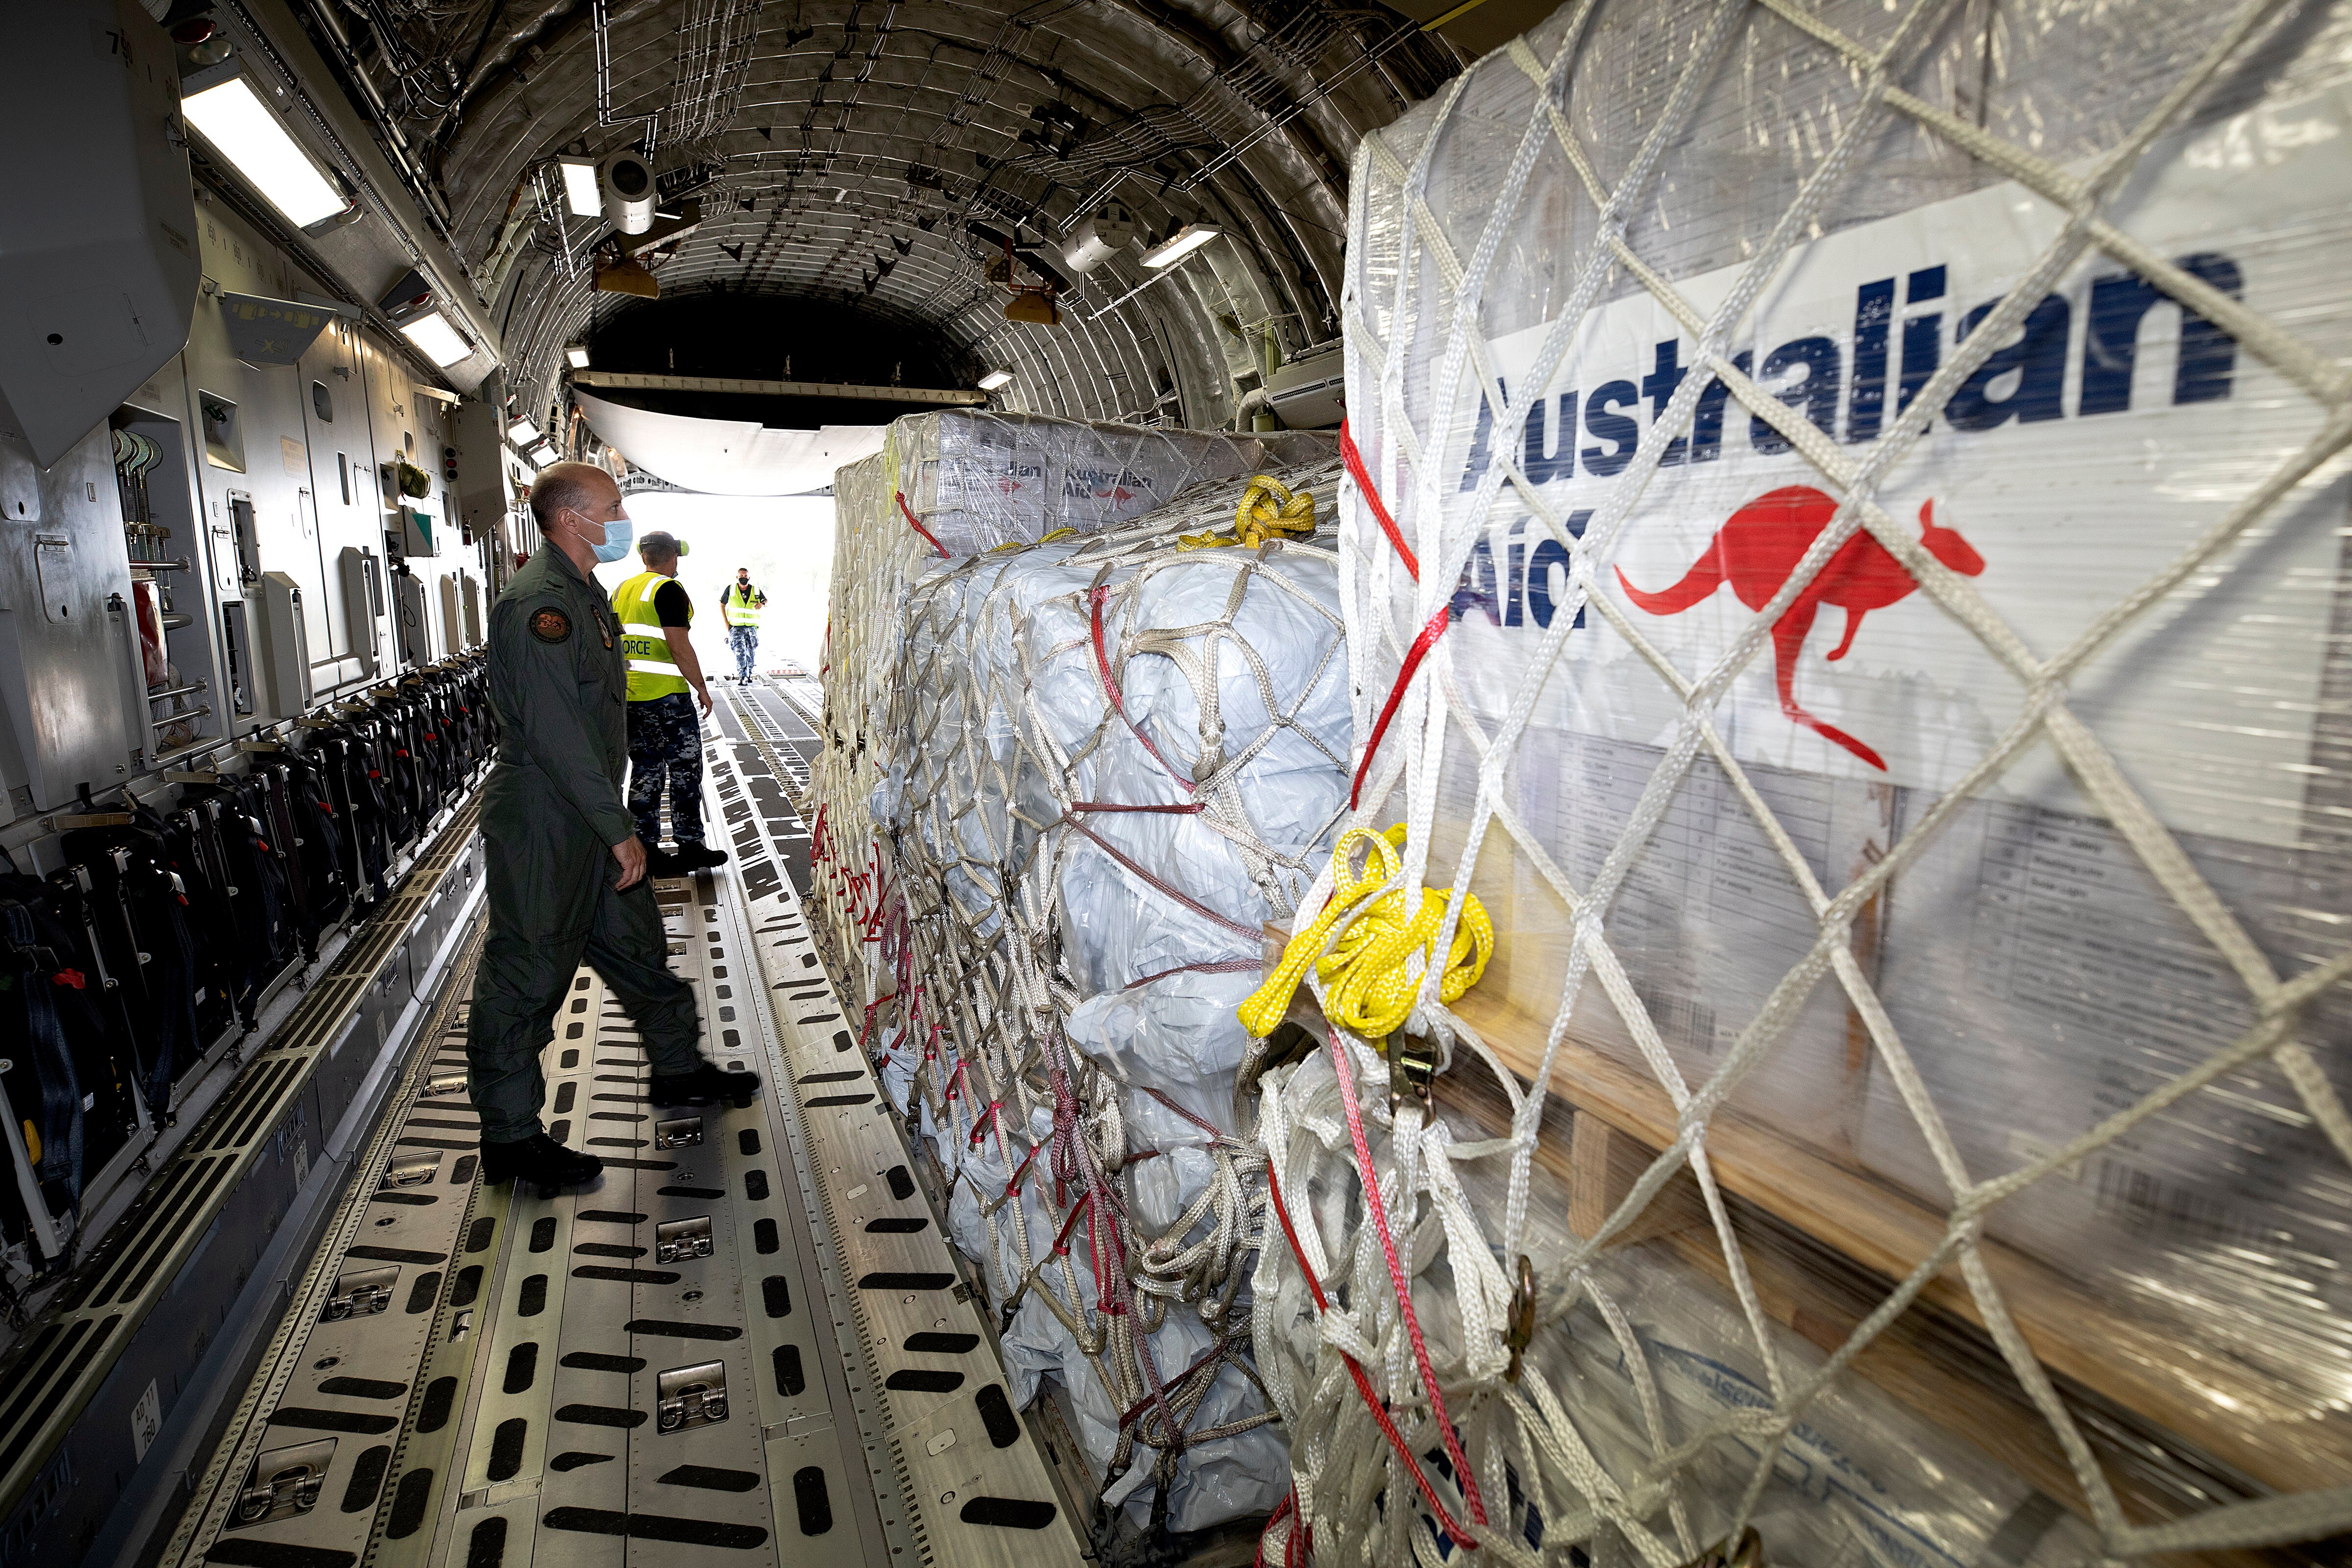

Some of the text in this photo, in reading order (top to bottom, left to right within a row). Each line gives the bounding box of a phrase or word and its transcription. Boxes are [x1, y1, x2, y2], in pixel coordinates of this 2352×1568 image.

[1459, 252, 2245, 494] Australian
[1062, 482, 1092, 499] Aid
[1448, 508, 1598, 630] Aid
[623, 640, 651, 655] ORCE
[136, 1386, 154, 1426] AD 11
[142, 1418, 155, 1449] 760
